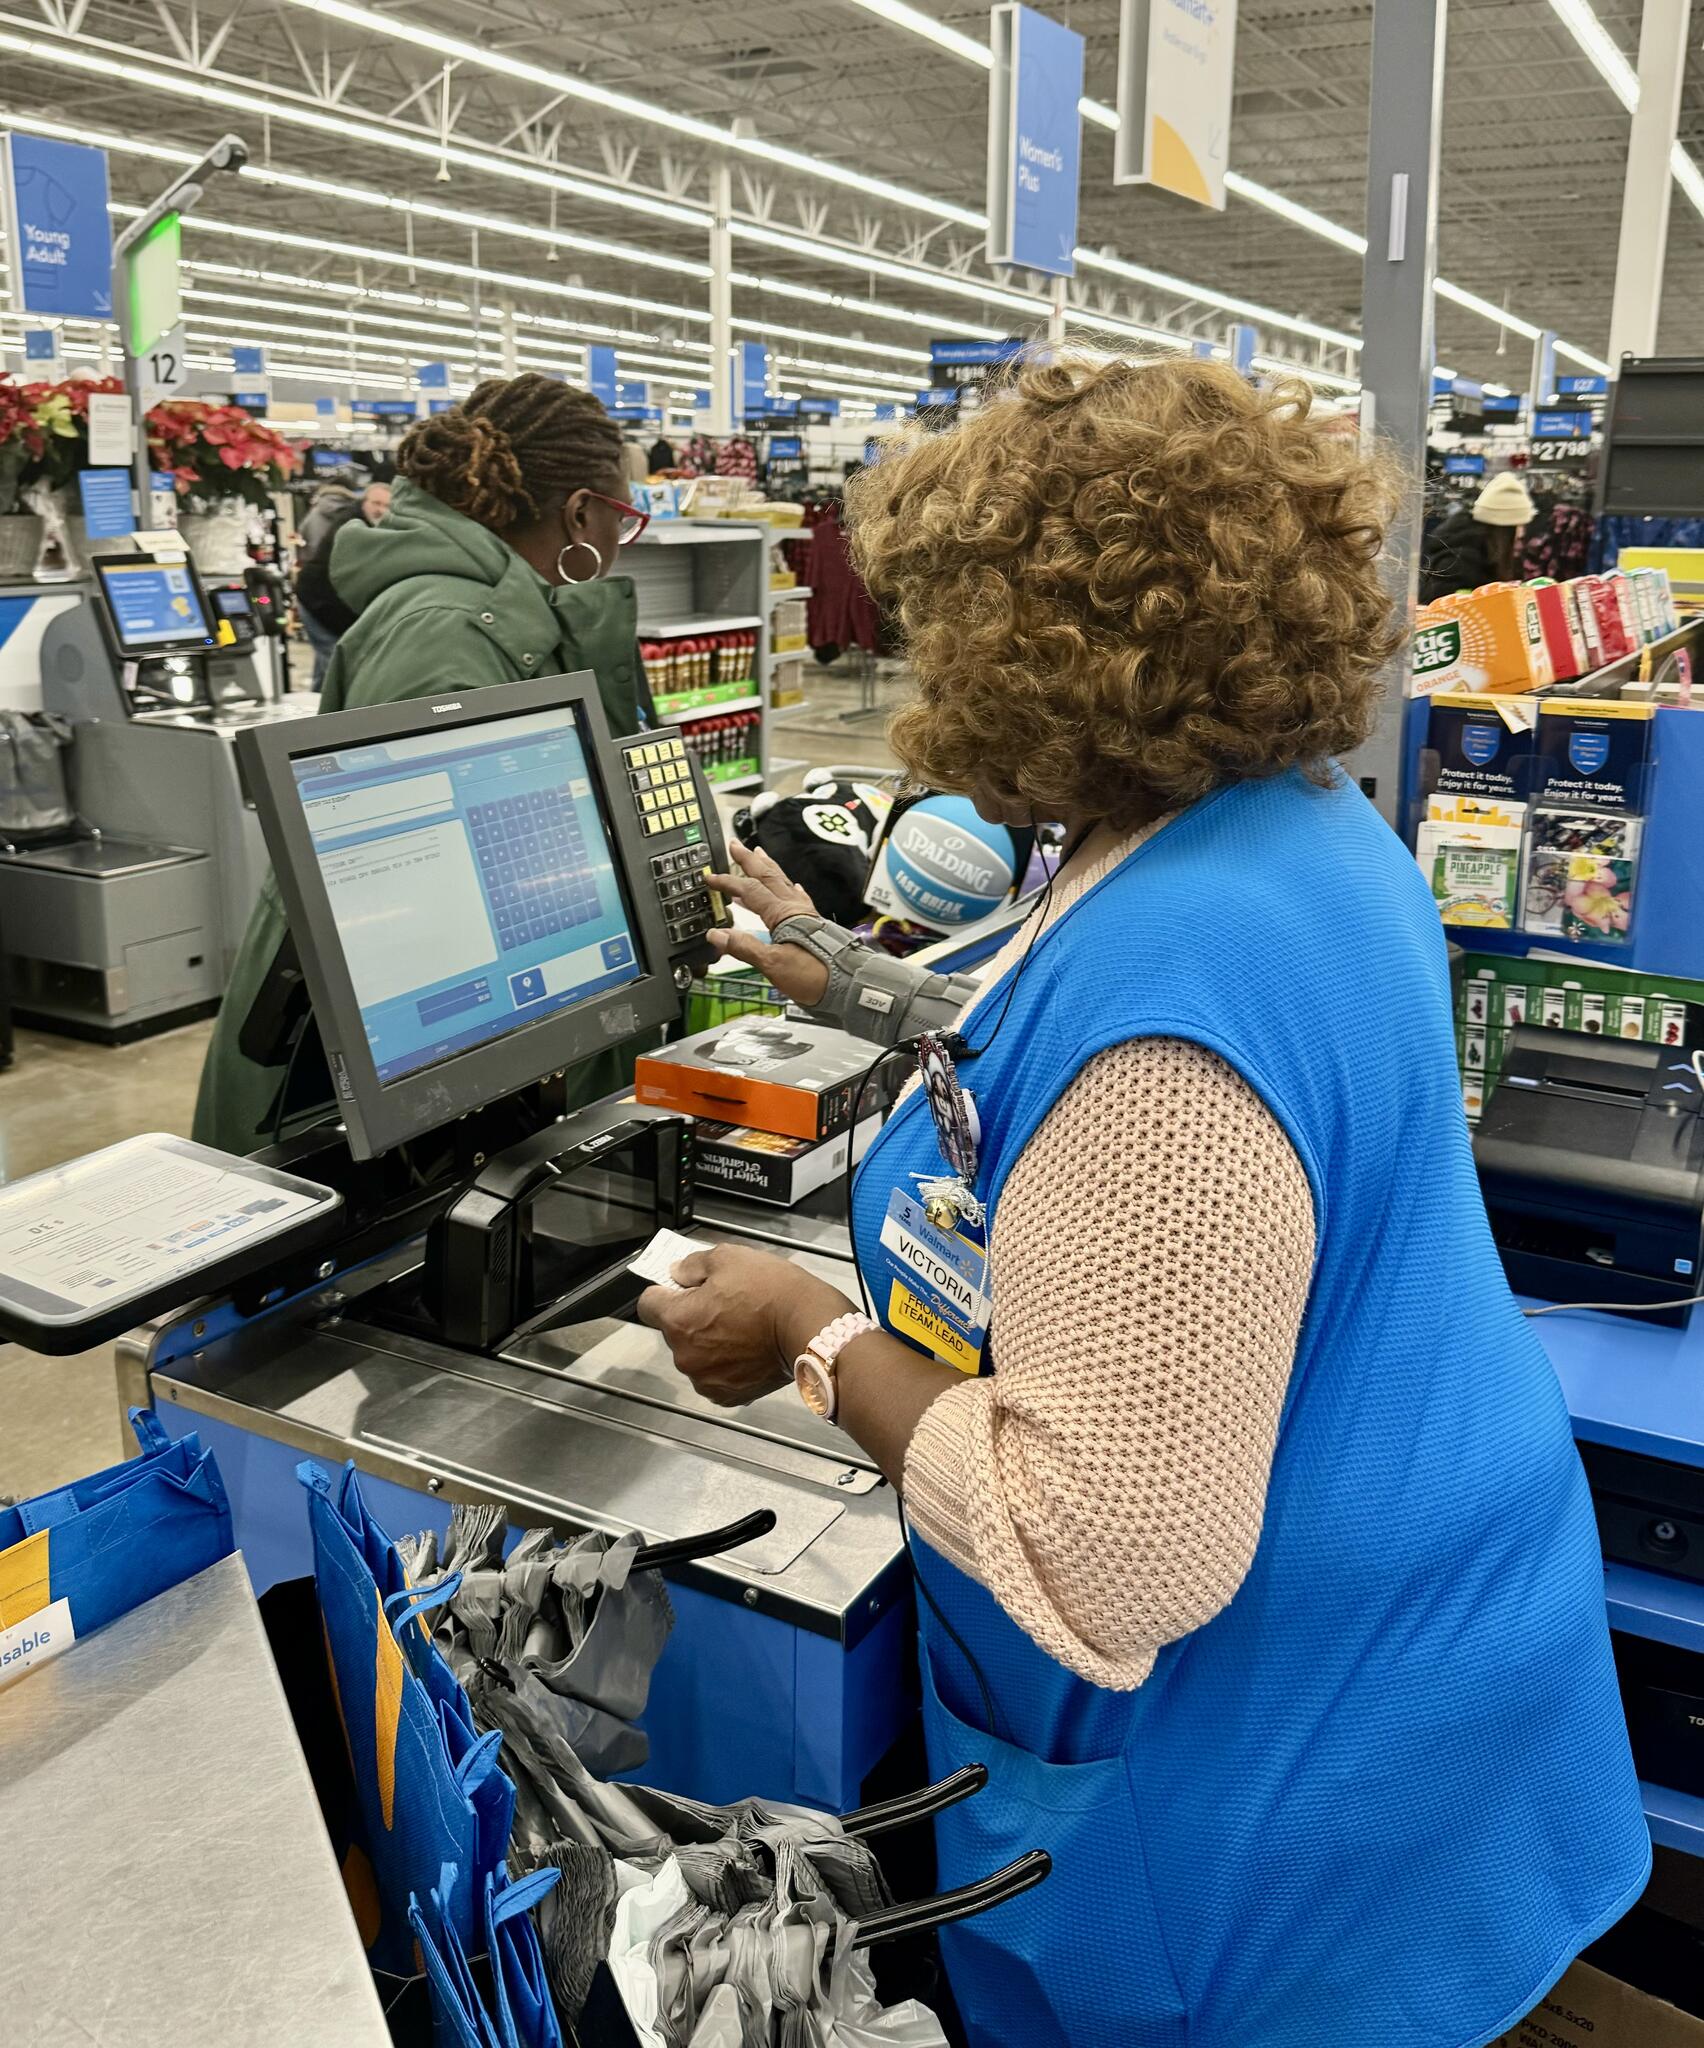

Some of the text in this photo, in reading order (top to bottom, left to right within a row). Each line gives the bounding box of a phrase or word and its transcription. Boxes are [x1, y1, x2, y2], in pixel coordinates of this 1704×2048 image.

[1019, 135, 1063, 172] Women's
[1019, 165, 1040, 192] Plus
[24, 224, 70, 250] Young
[26, 245, 67, 265] Adult
[151, 353, 177, 384] 12
[1413, 629, 1457, 655] tic
[1412, 648, 1456, 668] tac
[1415, 670, 1460, 693] ORANGE
[432, 702, 462, 714] TOSHIBA
[1438, 778, 1516, 795] Enjoy it for years.
[1442, 768, 1512, 784] Protect it today.
[1548, 779, 1623, 794] Protect it today.
[1544, 789, 1625, 804] Enjoy it for years.
[902, 826, 995, 891] SPALDING
[1450, 862, 1501, 876] PINEAPPLE
[895, 870, 922, 898] FAST
[920, 891, 965, 915] BREAK
[866, 996, 886, 1008] ACE
[696, 1161, 769, 1188] Better Homes
[903, 1207, 912, 1220] 5
[920, 1224, 961, 1266] Walmart
[892, 1264, 910, 1279] People
[907, 1277, 921, 1289] Make
[900, 1235, 972, 1310] VICTORIA
[908, 1294, 943, 1324] FRON
[904, 1302, 934, 1331] TEAM
[936, 1324, 964, 1352] LEAD
